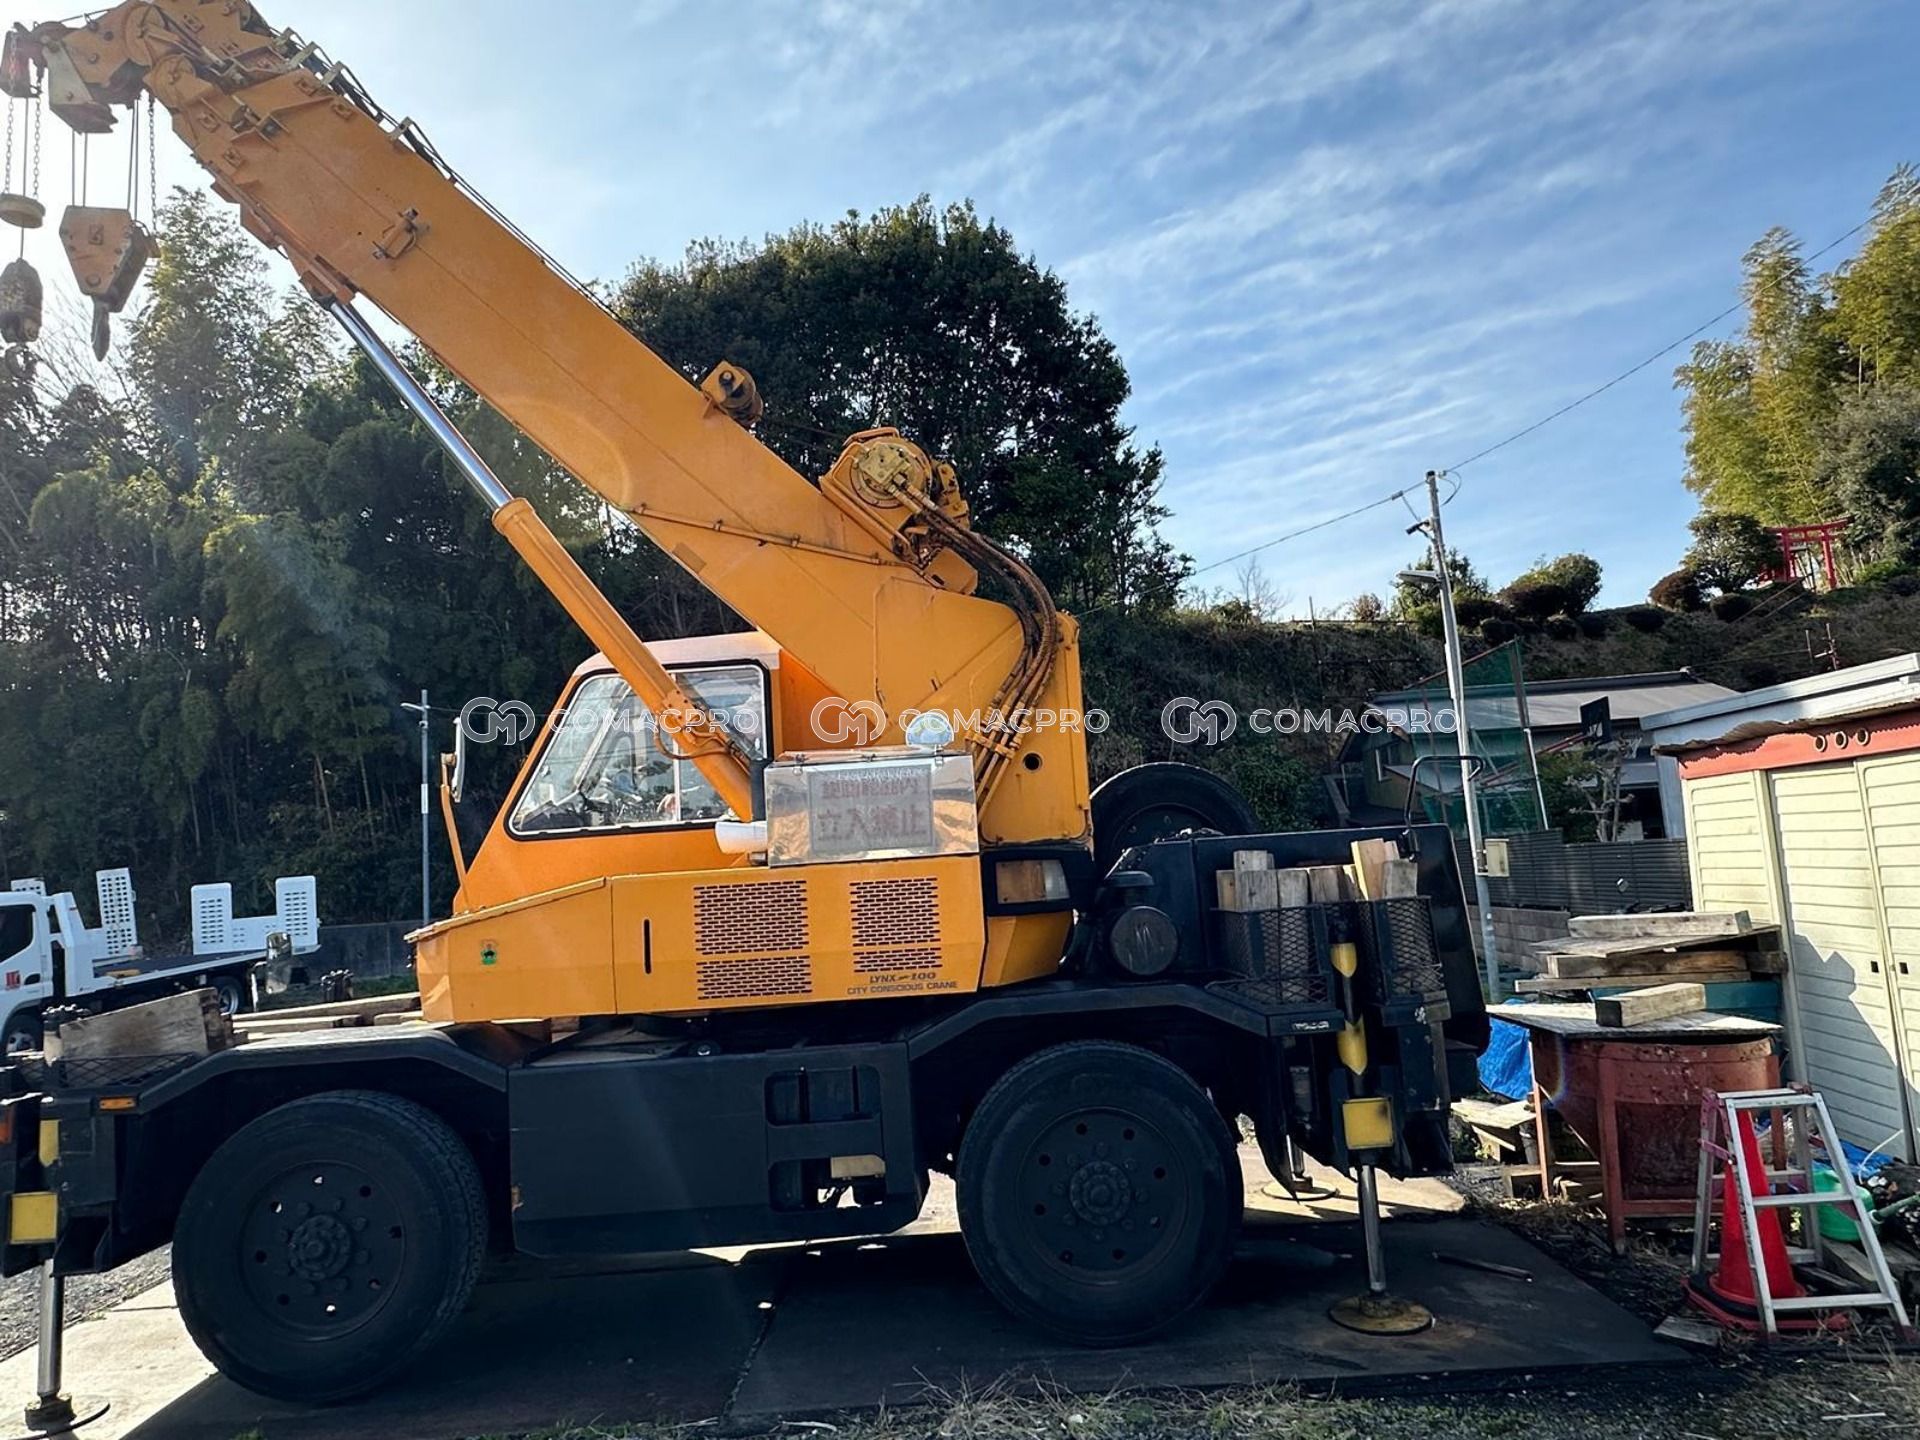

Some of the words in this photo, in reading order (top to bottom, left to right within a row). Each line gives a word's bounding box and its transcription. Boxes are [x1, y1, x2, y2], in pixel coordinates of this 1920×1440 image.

[847, 986, 868, 995] CITY
[870, 983, 923, 993] CONSCIOUS
[926, 981, 957, 990] CRANE
